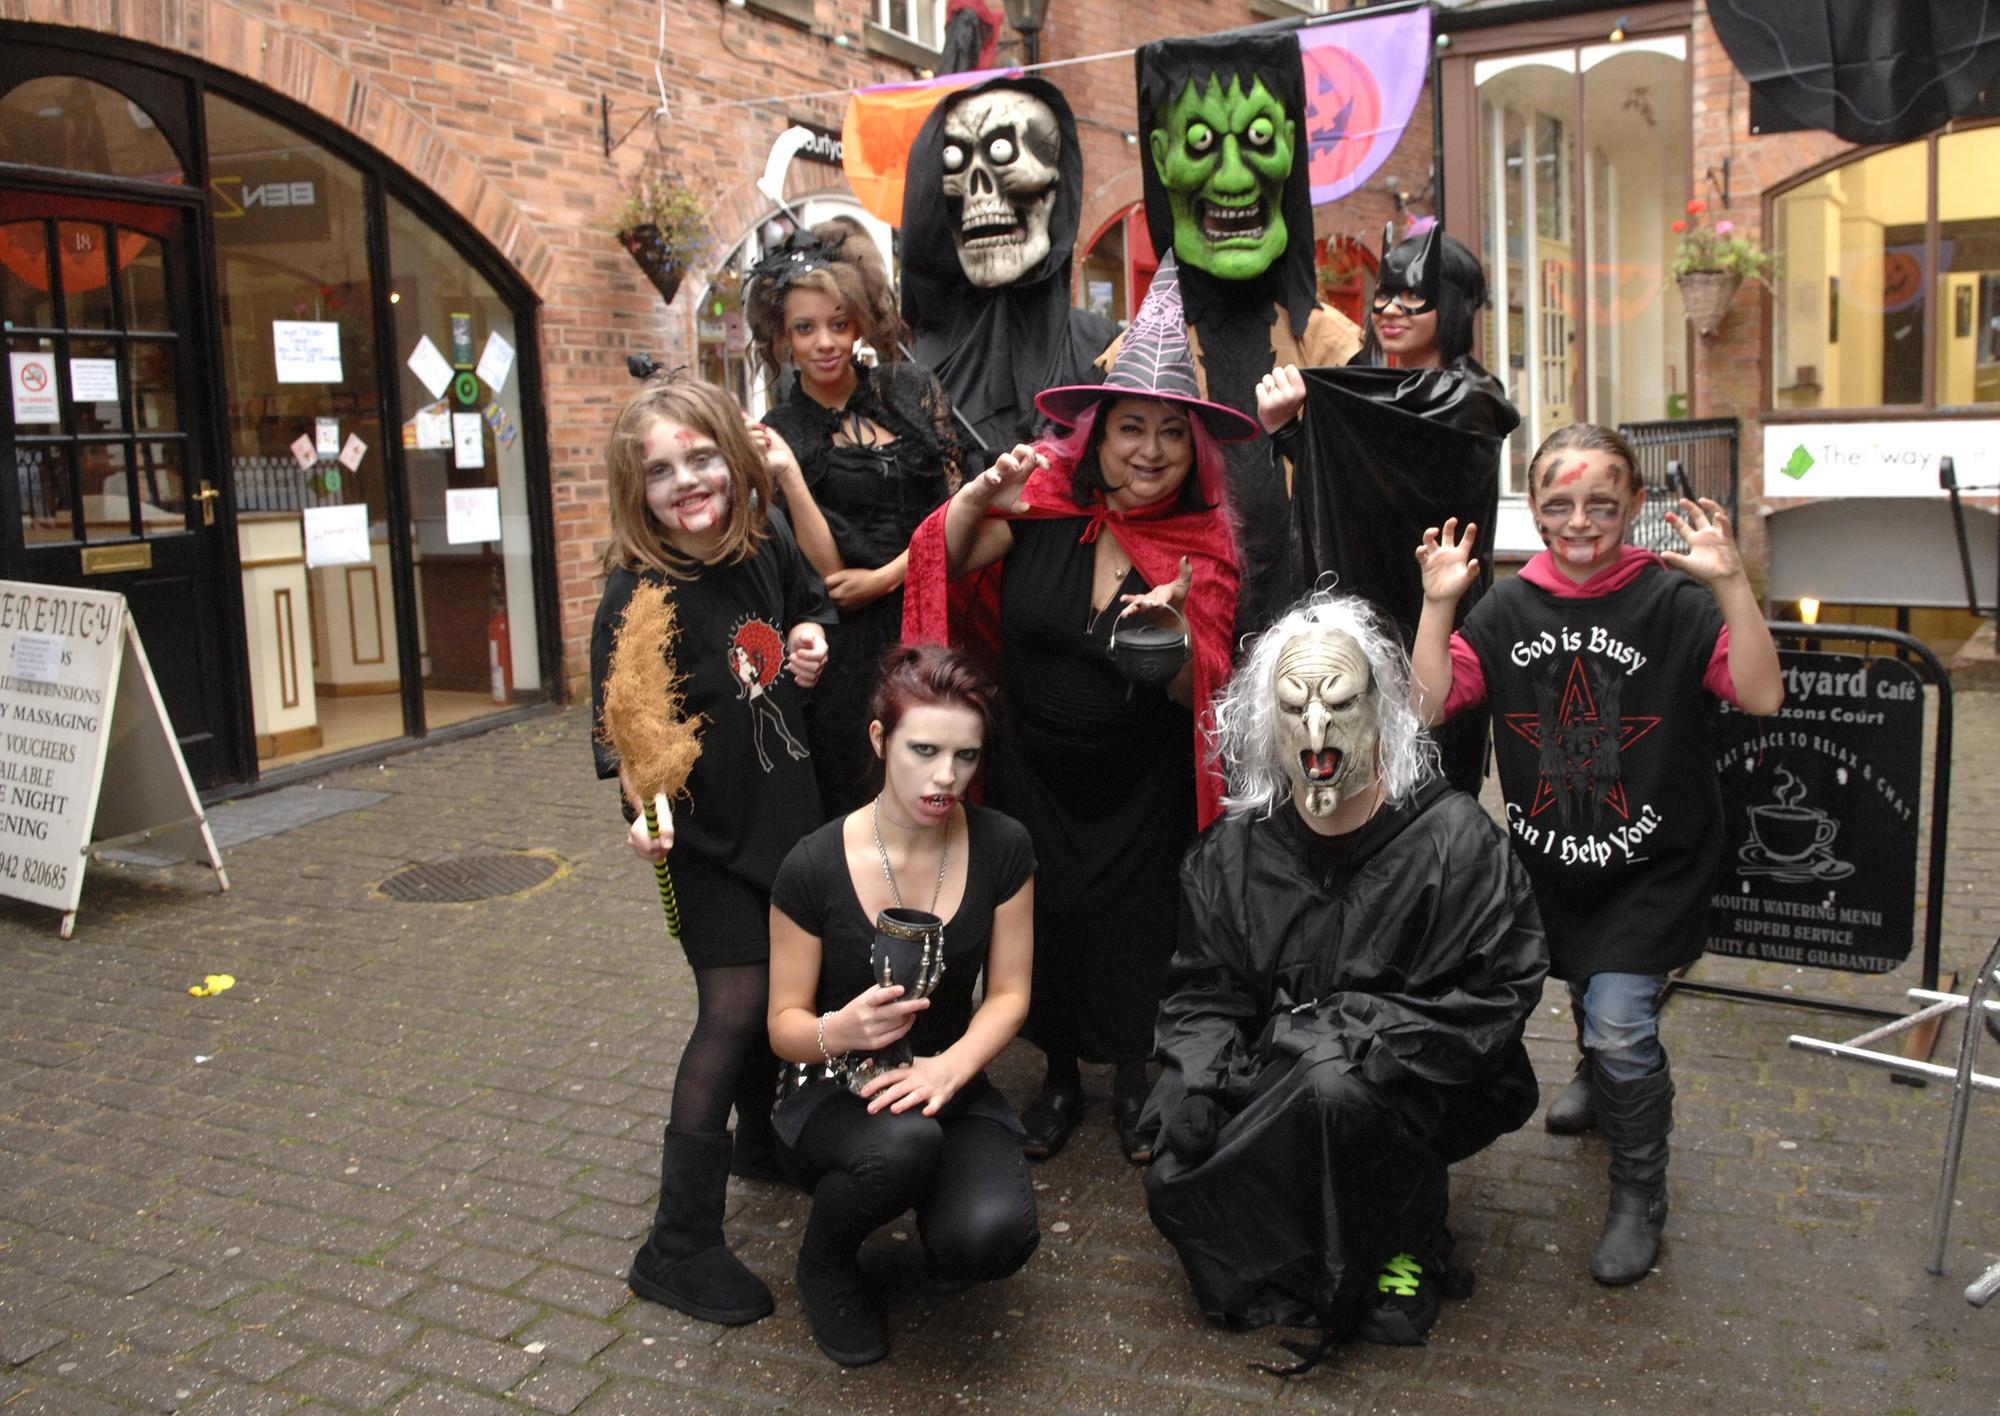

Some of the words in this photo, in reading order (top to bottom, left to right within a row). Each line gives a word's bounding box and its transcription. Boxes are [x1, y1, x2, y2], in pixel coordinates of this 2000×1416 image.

[0, 592, 113, 645] ERENITY
[1511, 631, 1556, 667] God
[1561, 626, 1582, 651] is
[1587, 626, 1648, 675] Busy
[1876, 680, 1916, 700] Café
[13, 705, 98, 733] MASSAGING
[1830, 708, 1885, 724] Court
[7, 734, 76, 763] VOUCHERS
[1744, 732, 1784, 755] PLACE
[1790, 732, 1807, 747] TO
[1814, 735, 1857, 769] RELAX
[1863, 764, 1872, 780] &
[1877, 776, 1911, 820] CHAT
[11, 787, 69, 815] NIGHT
[1505, 802, 1540, 846] Can
[1543, 830, 1556, 854] I
[1559, 835, 1612, 867] Help
[1608, 804, 1663, 858] You?
[22, 857, 67, 890] 820685
[1762, 899, 1836, 921] WATERING
[1840, 908, 1882, 927] MENU
[1734, 918, 1790, 937] SUPERB
[1793, 926, 1854, 946] SERVICE
[1746, 941, 1758, 956] &
[1760, 943, 1804, 962] VALUE
